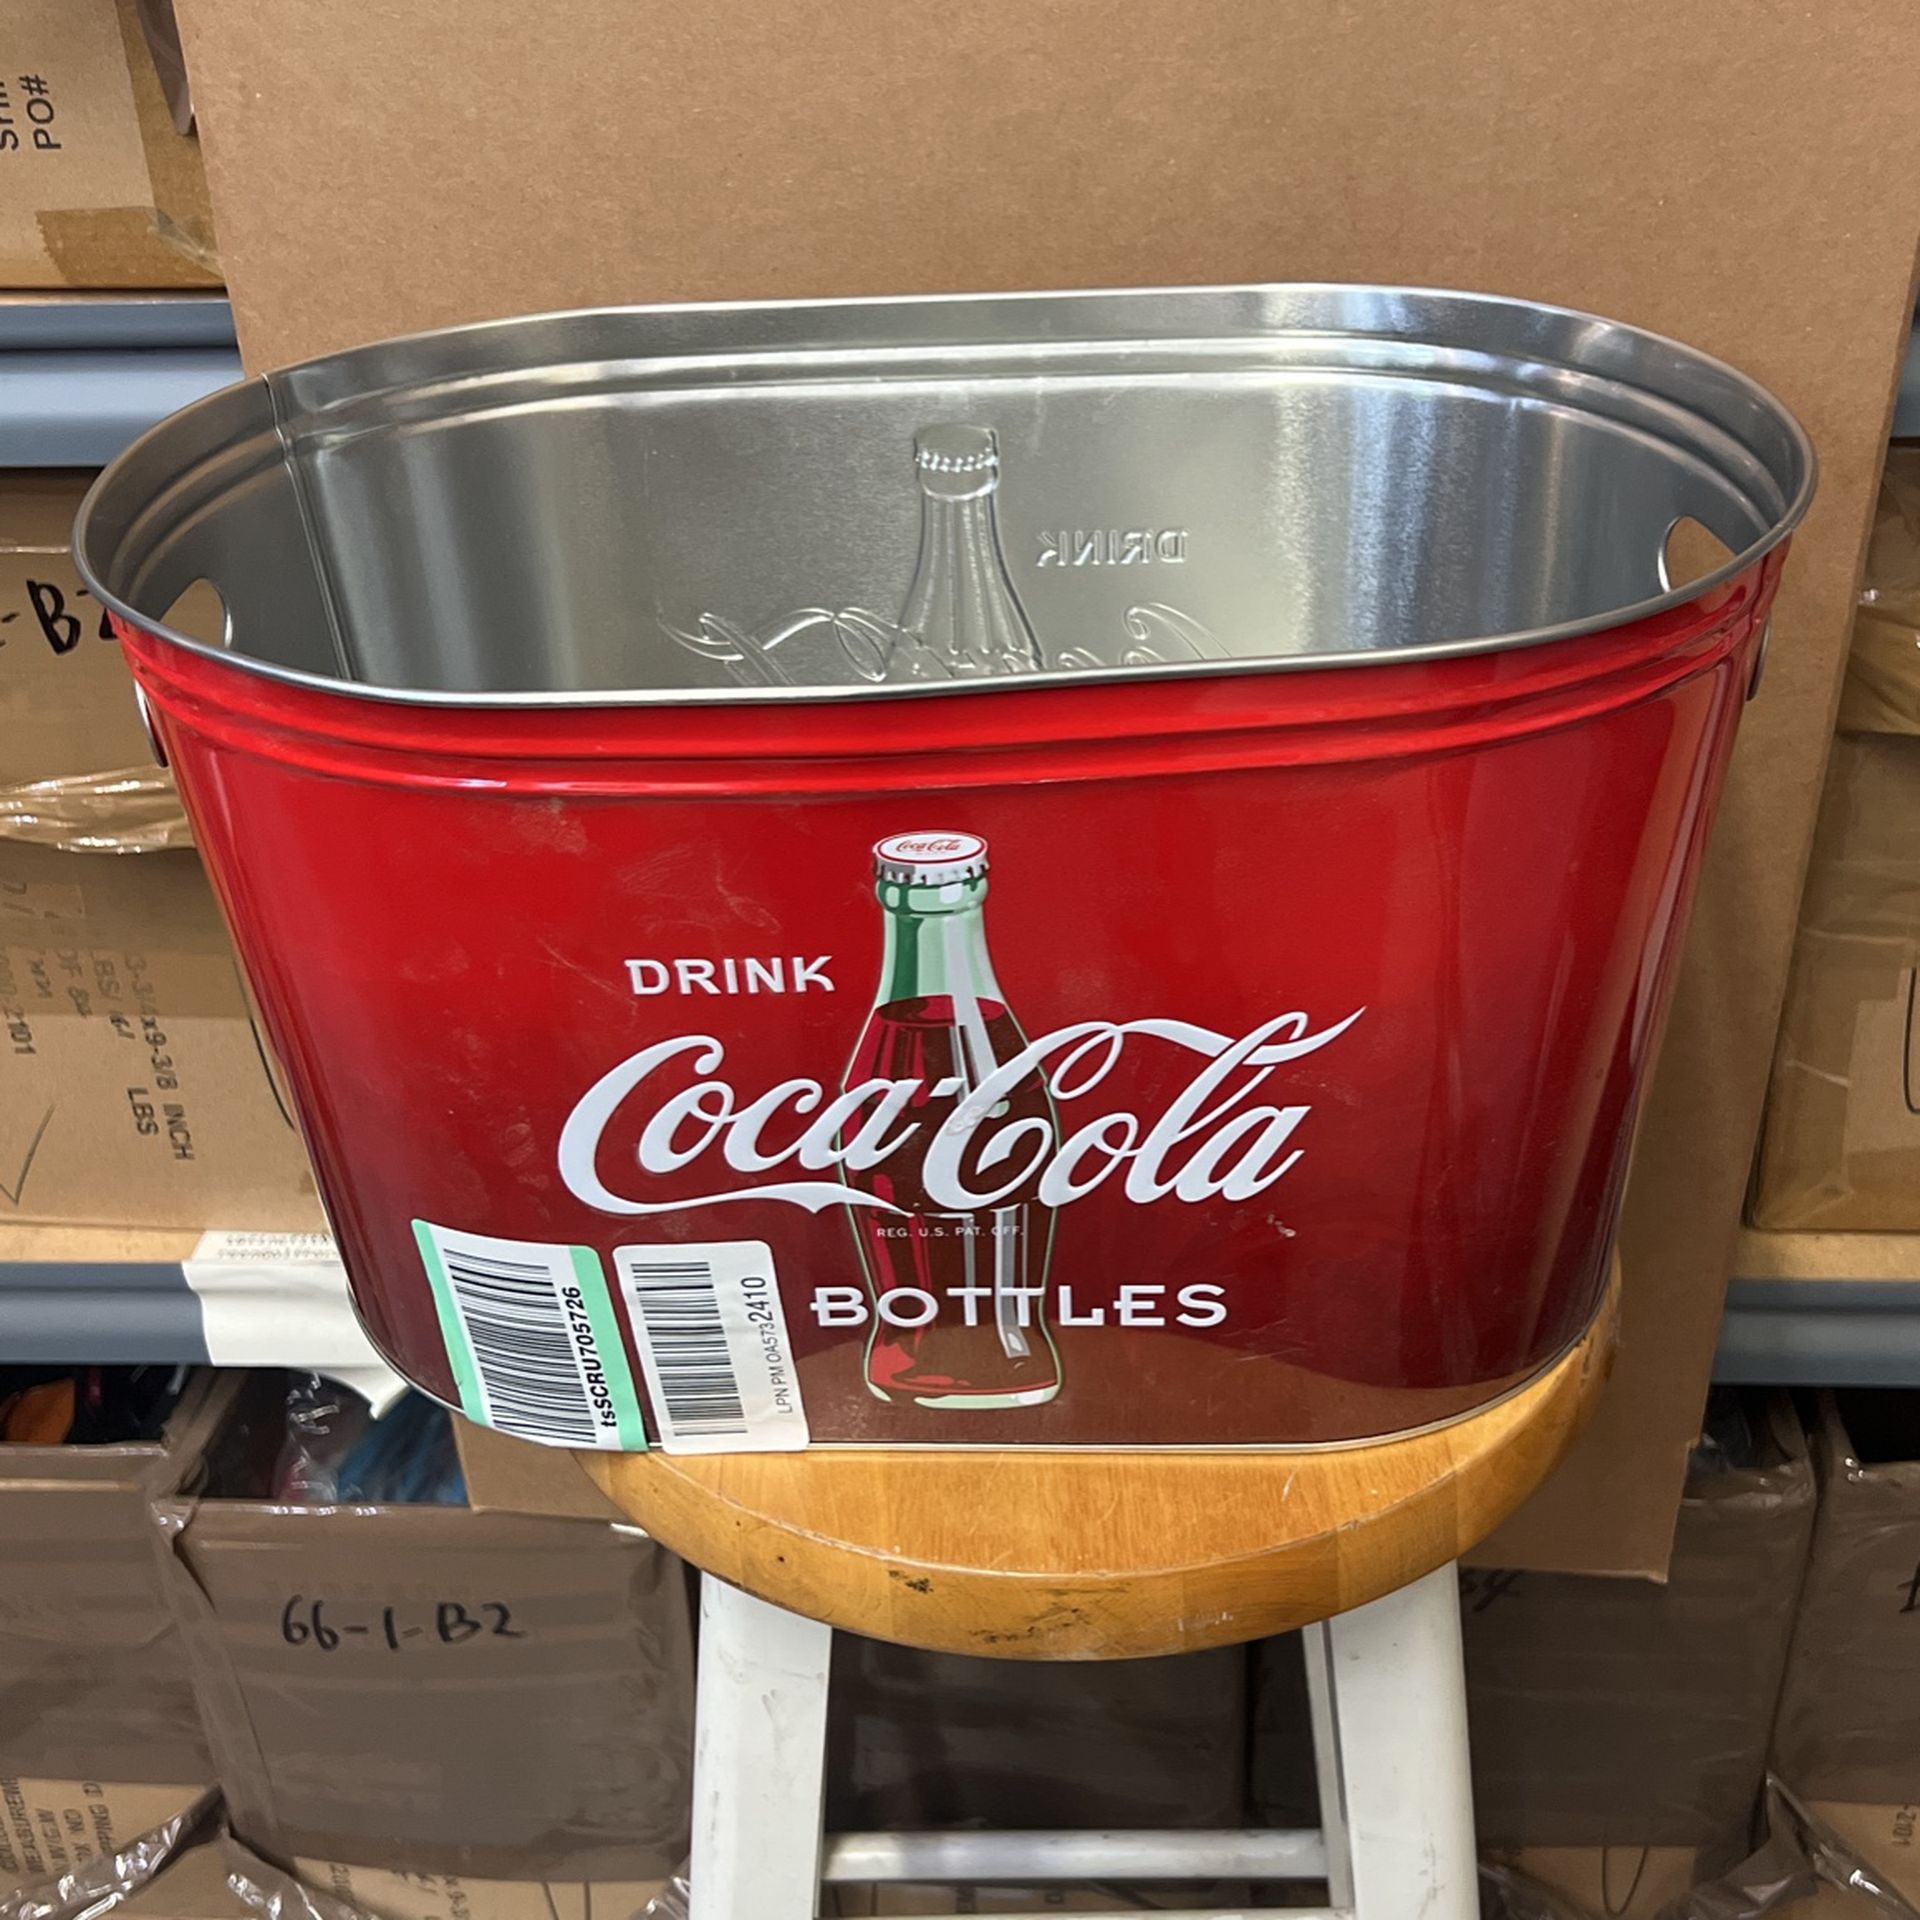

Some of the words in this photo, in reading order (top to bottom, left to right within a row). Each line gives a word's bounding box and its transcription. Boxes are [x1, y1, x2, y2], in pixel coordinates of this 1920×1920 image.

[19, 74, 61, 149] PO#
[625, 956, 834, 995] DRINK
[128, 1087, 159, 1136] LBS
[163, 1103, 195, 1160] INCH
[557, 1007, 1365, 1214] Coca-Cola
[810, 1284, 1228, 1329] BOTTLES
[562, 1287, 617, 1427] tsSCRU705726
[769, 1365, 787, 1386] PM
[775, 1387, 793, 1414] LPN
